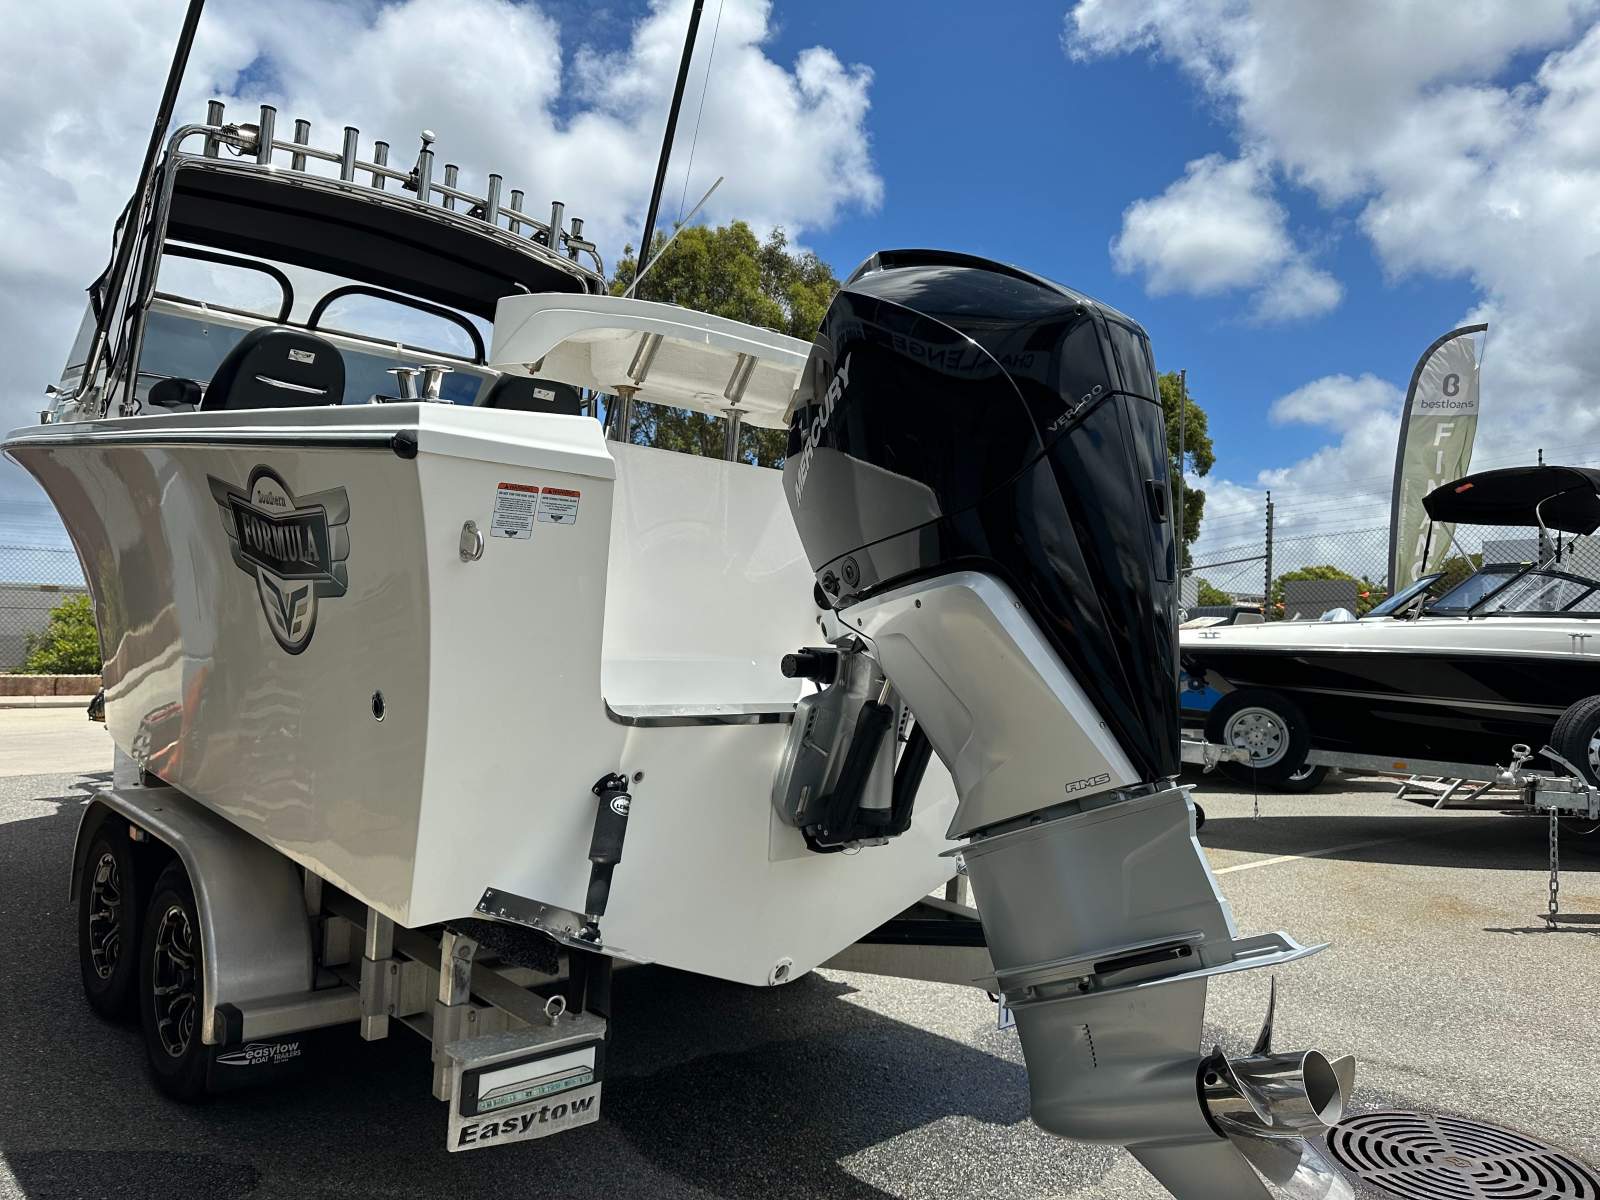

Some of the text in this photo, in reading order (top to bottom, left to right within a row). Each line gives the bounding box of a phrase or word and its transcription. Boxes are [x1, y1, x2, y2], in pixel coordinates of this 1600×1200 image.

[1047, 384, 1103, 431] VERADO
[1420, 399, 1474, 409] bestloans
[794, 352, 852, 507] MERCURY
[241, 512, 320, 562] FORMULA
[1065, 773, 1110, 793] AMS
[251, 1056, 269, 1064] BOAT
[273, 1049, 301, 1060] TRAILERS
[457, 1095, 595, 1148] Easytow
